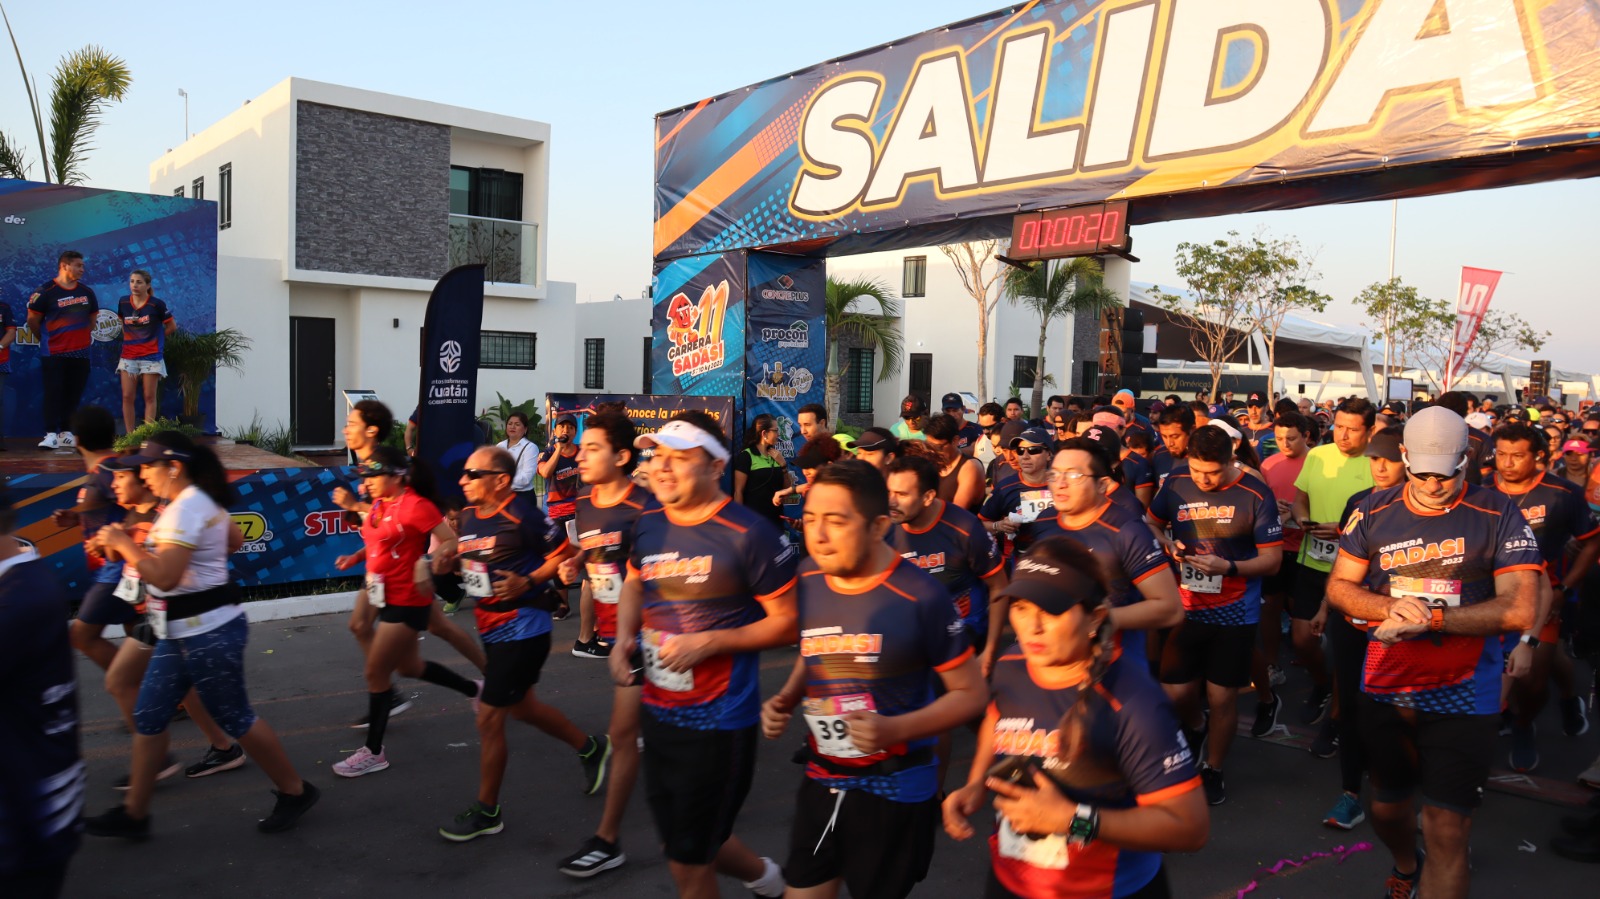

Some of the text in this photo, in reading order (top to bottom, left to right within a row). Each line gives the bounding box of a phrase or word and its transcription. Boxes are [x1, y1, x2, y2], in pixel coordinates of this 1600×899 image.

[791, 0, 1545, 218] SALIDA
[4, 214, 26, 225] de:
[668, 334, 712, 360] CARRERA
[673, 342, 724, 375] SADASI
[1177, 506, 1236, 521] SADASI
[1379, 538, 1424, 553] CARRERA
[1380, 537, 1465, 571] SADASI
[1441, 556, 1464, 566] 2023
